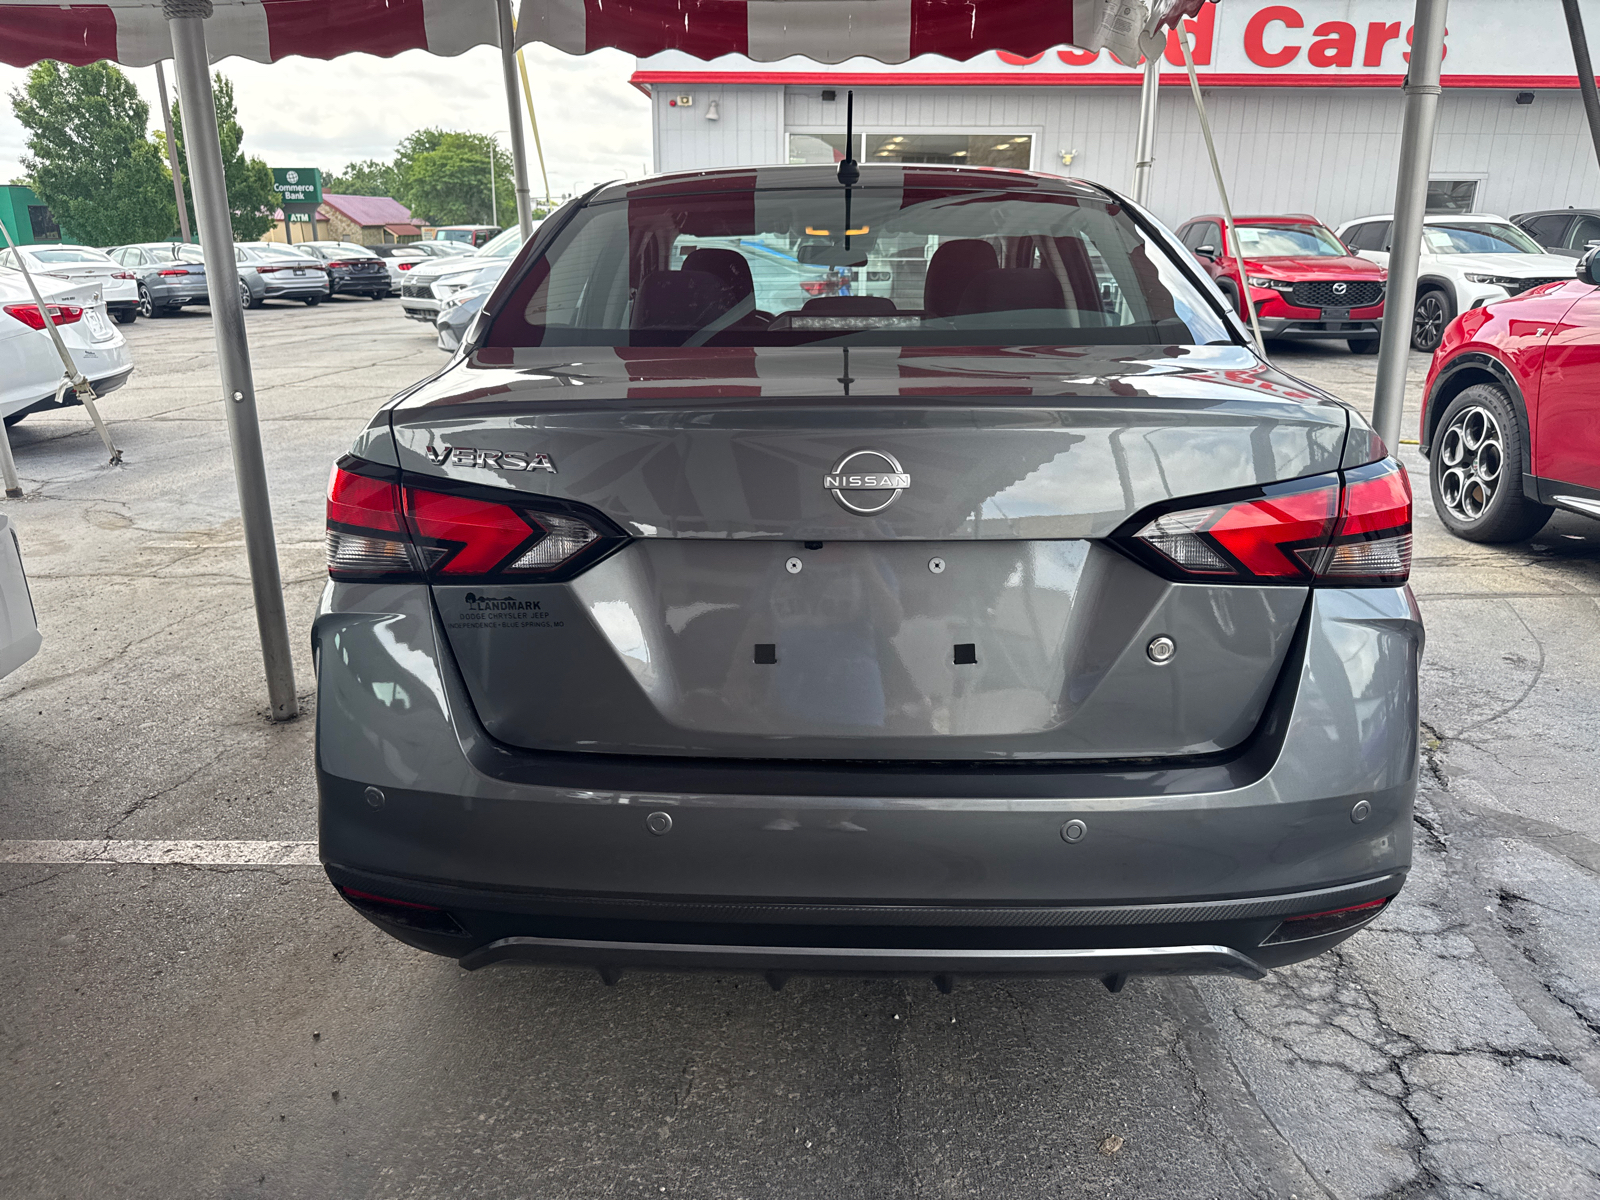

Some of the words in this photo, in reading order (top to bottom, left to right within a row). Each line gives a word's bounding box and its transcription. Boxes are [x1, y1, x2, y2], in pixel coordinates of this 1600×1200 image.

[273, 183, 315, 192] Commerce
[284, 191, 305, 200] Bank
[290, 213, 309, 222] ATM
[426, 445, 558, 474] VERSA
[826, 475, 909, 487] NISSAN
[477, 601, 541, 611] LANDMARK
